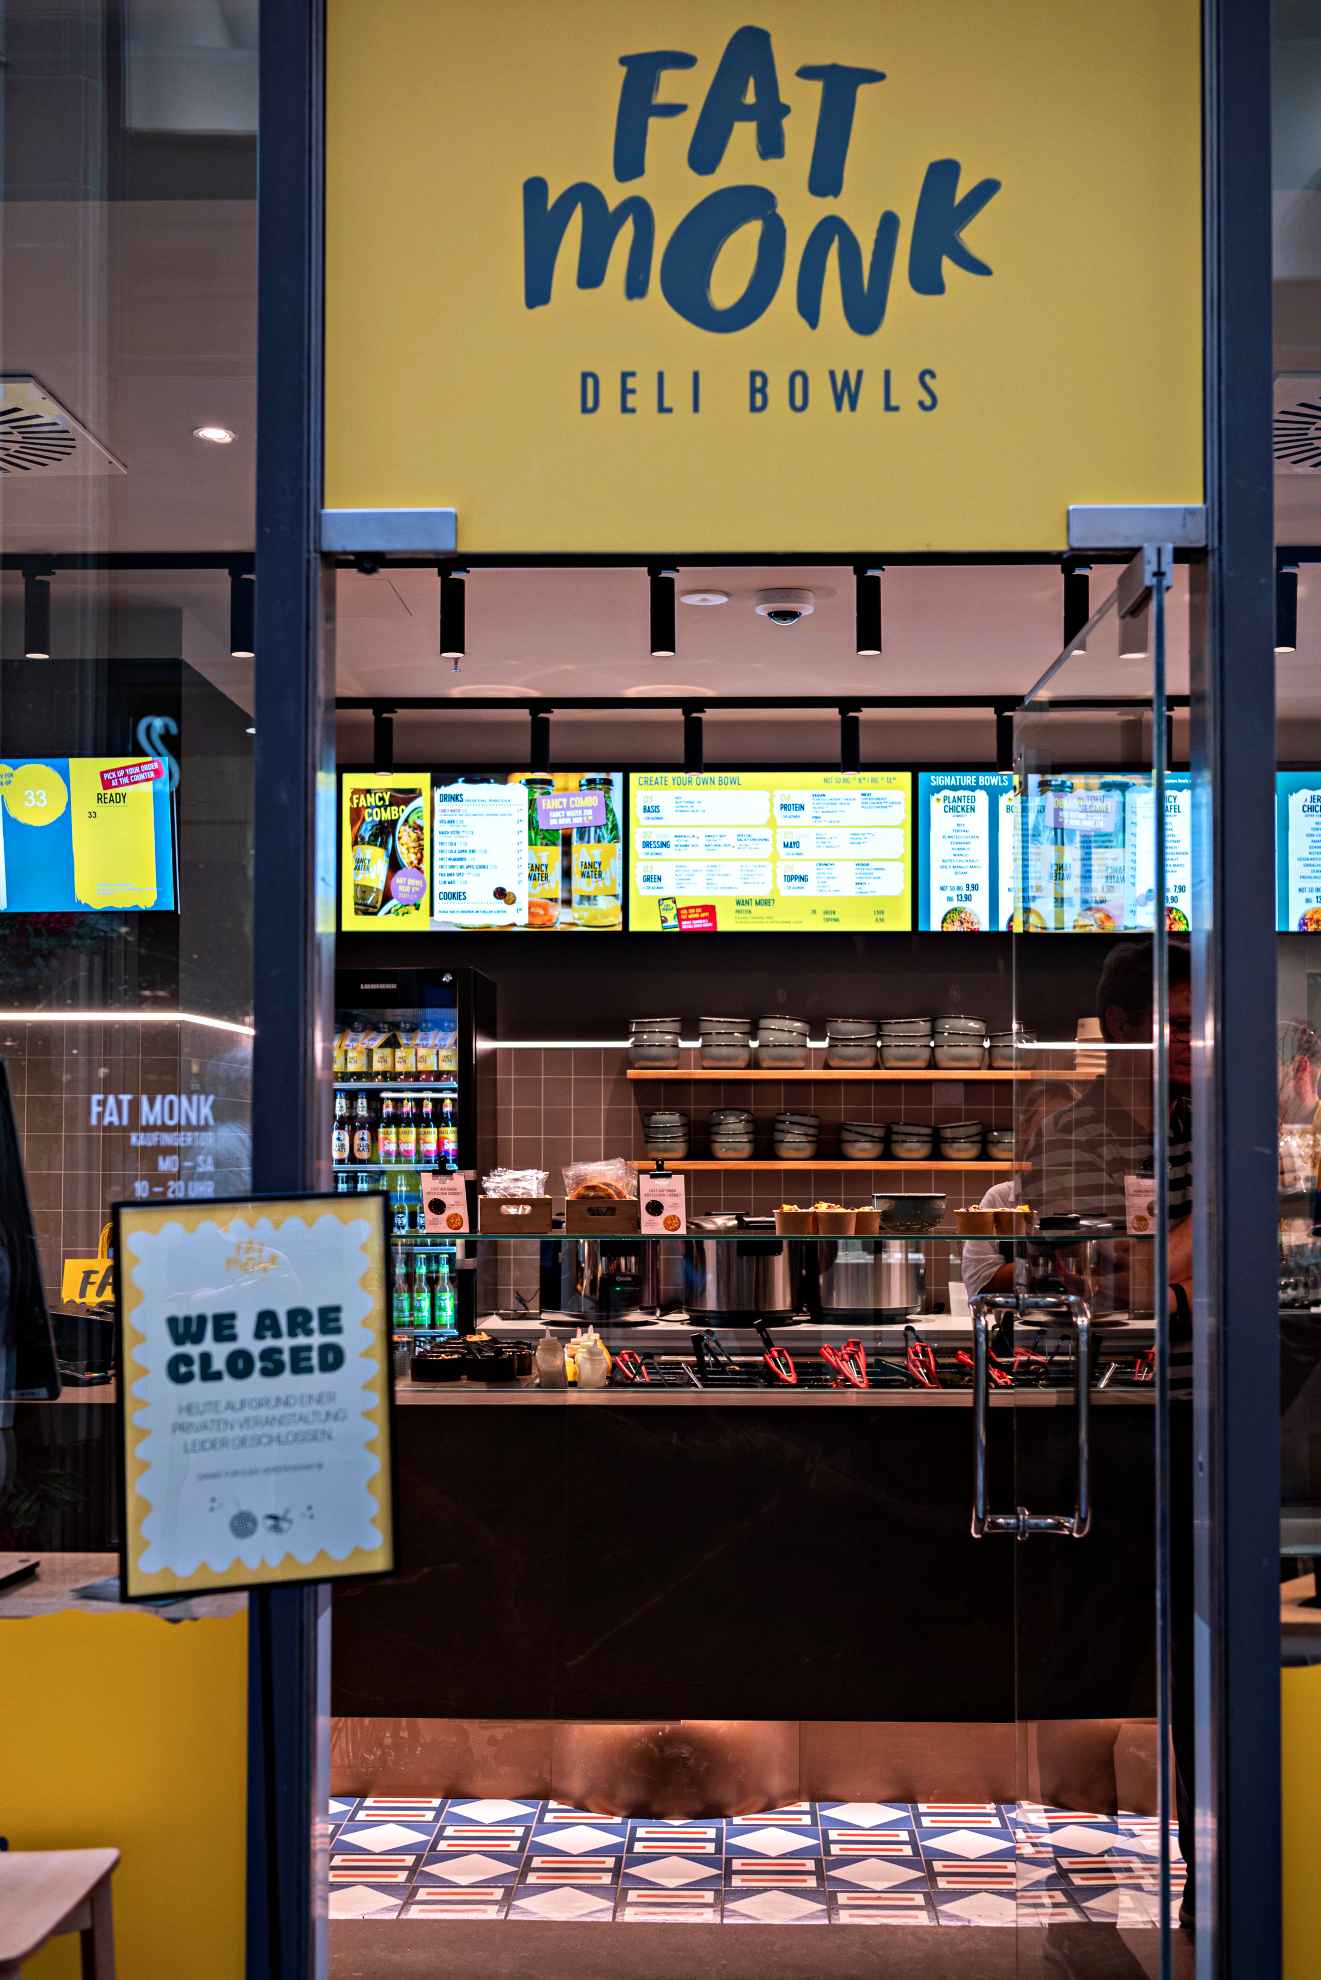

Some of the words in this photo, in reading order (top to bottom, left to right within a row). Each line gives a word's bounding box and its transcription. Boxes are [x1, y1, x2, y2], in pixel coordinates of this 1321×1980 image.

[613, 25, 887, 199] FAT
[580, 370, 700, 414] DELI
[748, 368, 938, 414] BOWLS
[103, 772, 116, 780] PICK
[126, 767, 140, 775] YOUR
[638, 776, 668, 786] CREATE
[672, 776, 693, 786] YOUR
[695, 776, 716, 786] OWN
[718, 776, 742, 786] BOWL
[930, 775, 977, 786] SIGNATURE
[979, 775, 1008, 786] BOWLS
[25, 789, 48, 807] 33
[97, 792, 127, 804] READY
[353, 791, 390, 808] FANCY
[439, 793, 464, 803] DRINKS
[542, 797, 567, 809] FANCY
[569, 796, 598, 807] COMBO
[943, 795, 976, 804] PLANTED
[642, 805, 660, 814] BASIS
[780, 803, 805, 812] PROTEIN
[943, 805, 975, 813] CHICKEN
[88, 811, 97, 819] 33
[364, 805, 406, 821] COMBO
[642, 840, 671, 849] DRESSING
[783, 840, 800, 849] MAYO
[580, 861, 602, 870] FANCY
[528, 872, 549, 882] WATER
[580, 870, 602, 879] WATER
[642, 874, 662, 883] GREEN
[784, 874, 809, 883] TOPPING
[965, 883, 979, 892] 9,90
[1173, 884, 1186, 893] 7,90
[438, 891, 467, 901] COOKIES
[956, 894, 972, 903] 13,90
[735, 898, 753, 907] WANT
[755, 898, 775, 907] MORE?
[90, 1094, 133, 1126] FAT
[140, 1094, 215, 1126] MONK
[157, 1155, 179, 1172] MO
[196, 1155, 215, 1172] SA
[133, 1181, 149, 1197] 10
[167, 1181, 185, 1197] 20
[188, 1181, 215, 1197] UHR
[79, 1265, 115, 1299] FA
[166, 1312, 238, 1347] WE
[253, 1305, 343, 1341] ARE
[166, 1343, 346, 1385] CLOSED
[178, 1400, 221, 1416] HEUTE
